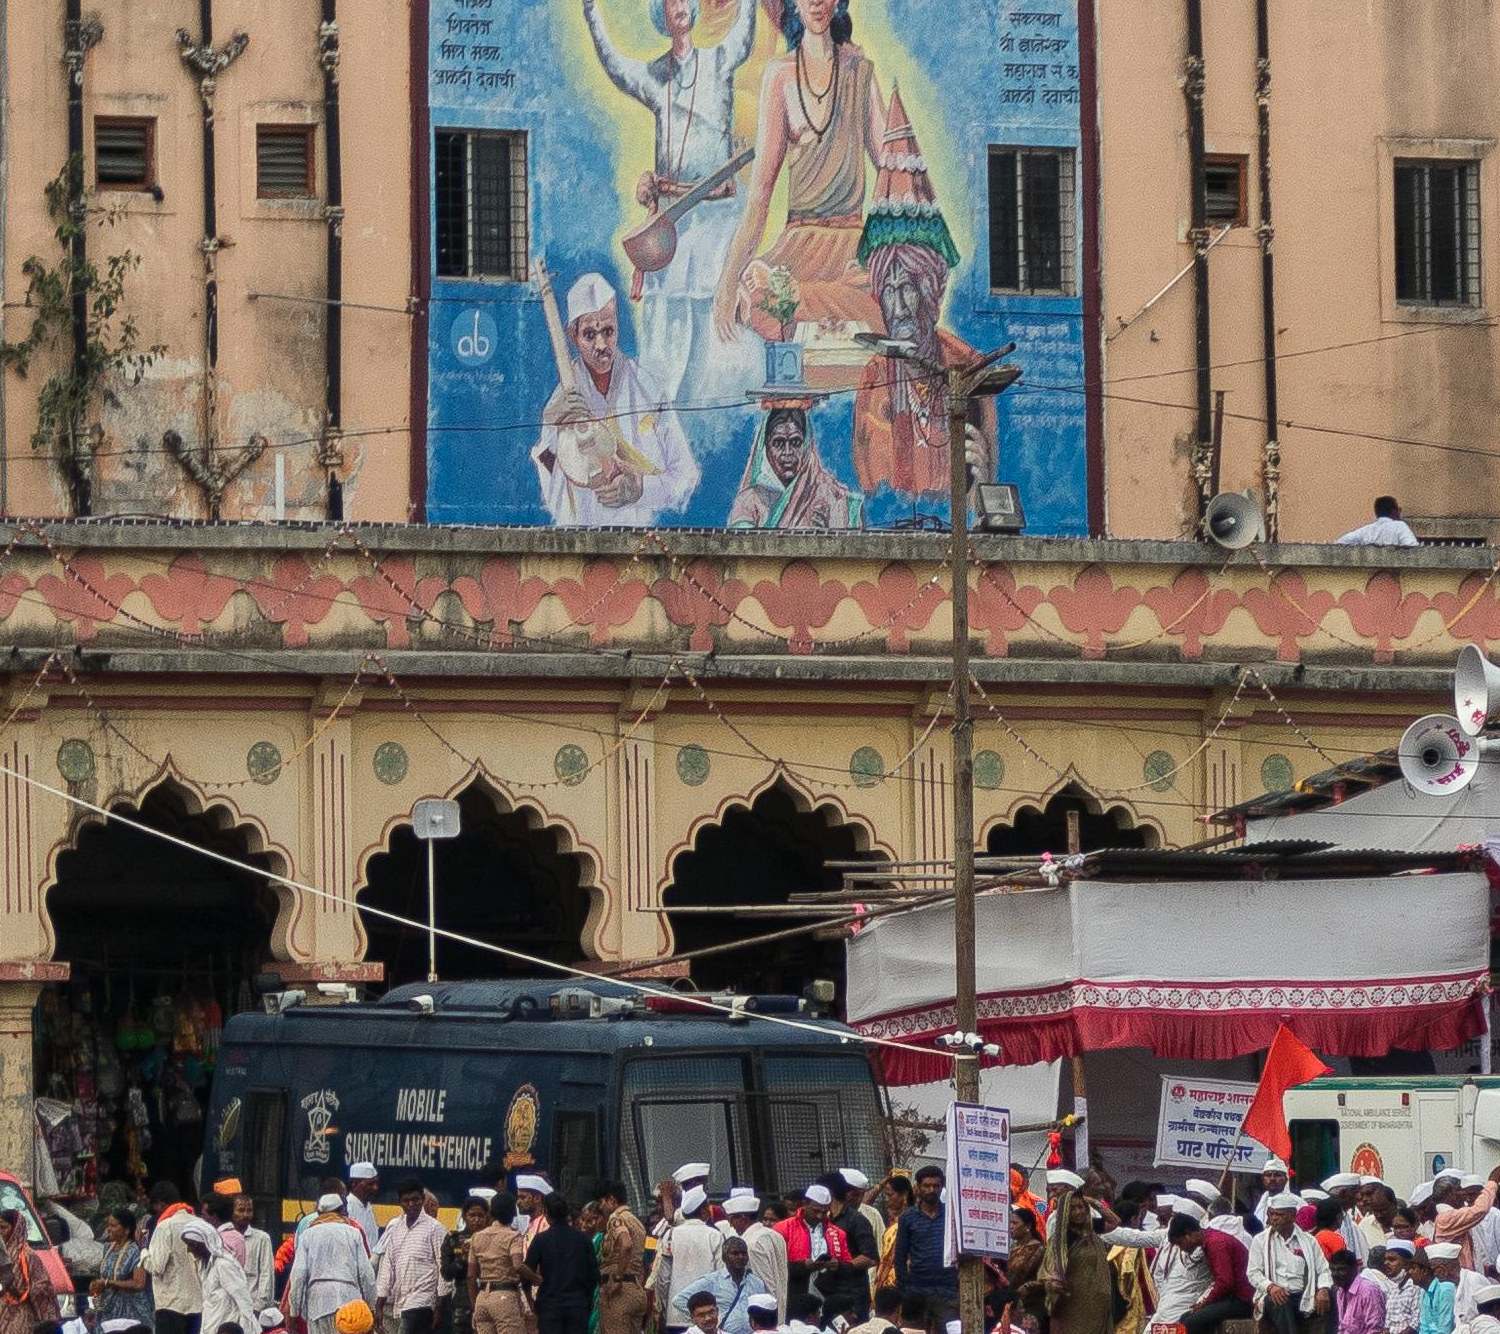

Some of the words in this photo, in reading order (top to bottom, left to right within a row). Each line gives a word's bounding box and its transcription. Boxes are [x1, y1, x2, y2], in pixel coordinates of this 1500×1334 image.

[457, 310, 490, 358] ab
[396, 1088, 448, 1122] MOBILE
[1189, 1089, 1226, 1106] महाराष्ट्र
[344, 1132, 436, 1168] SURVEILLANCE
[438, 1135, 492, 1170] VEHICLE
[1176, 1139, 1204, 1157] घाट
